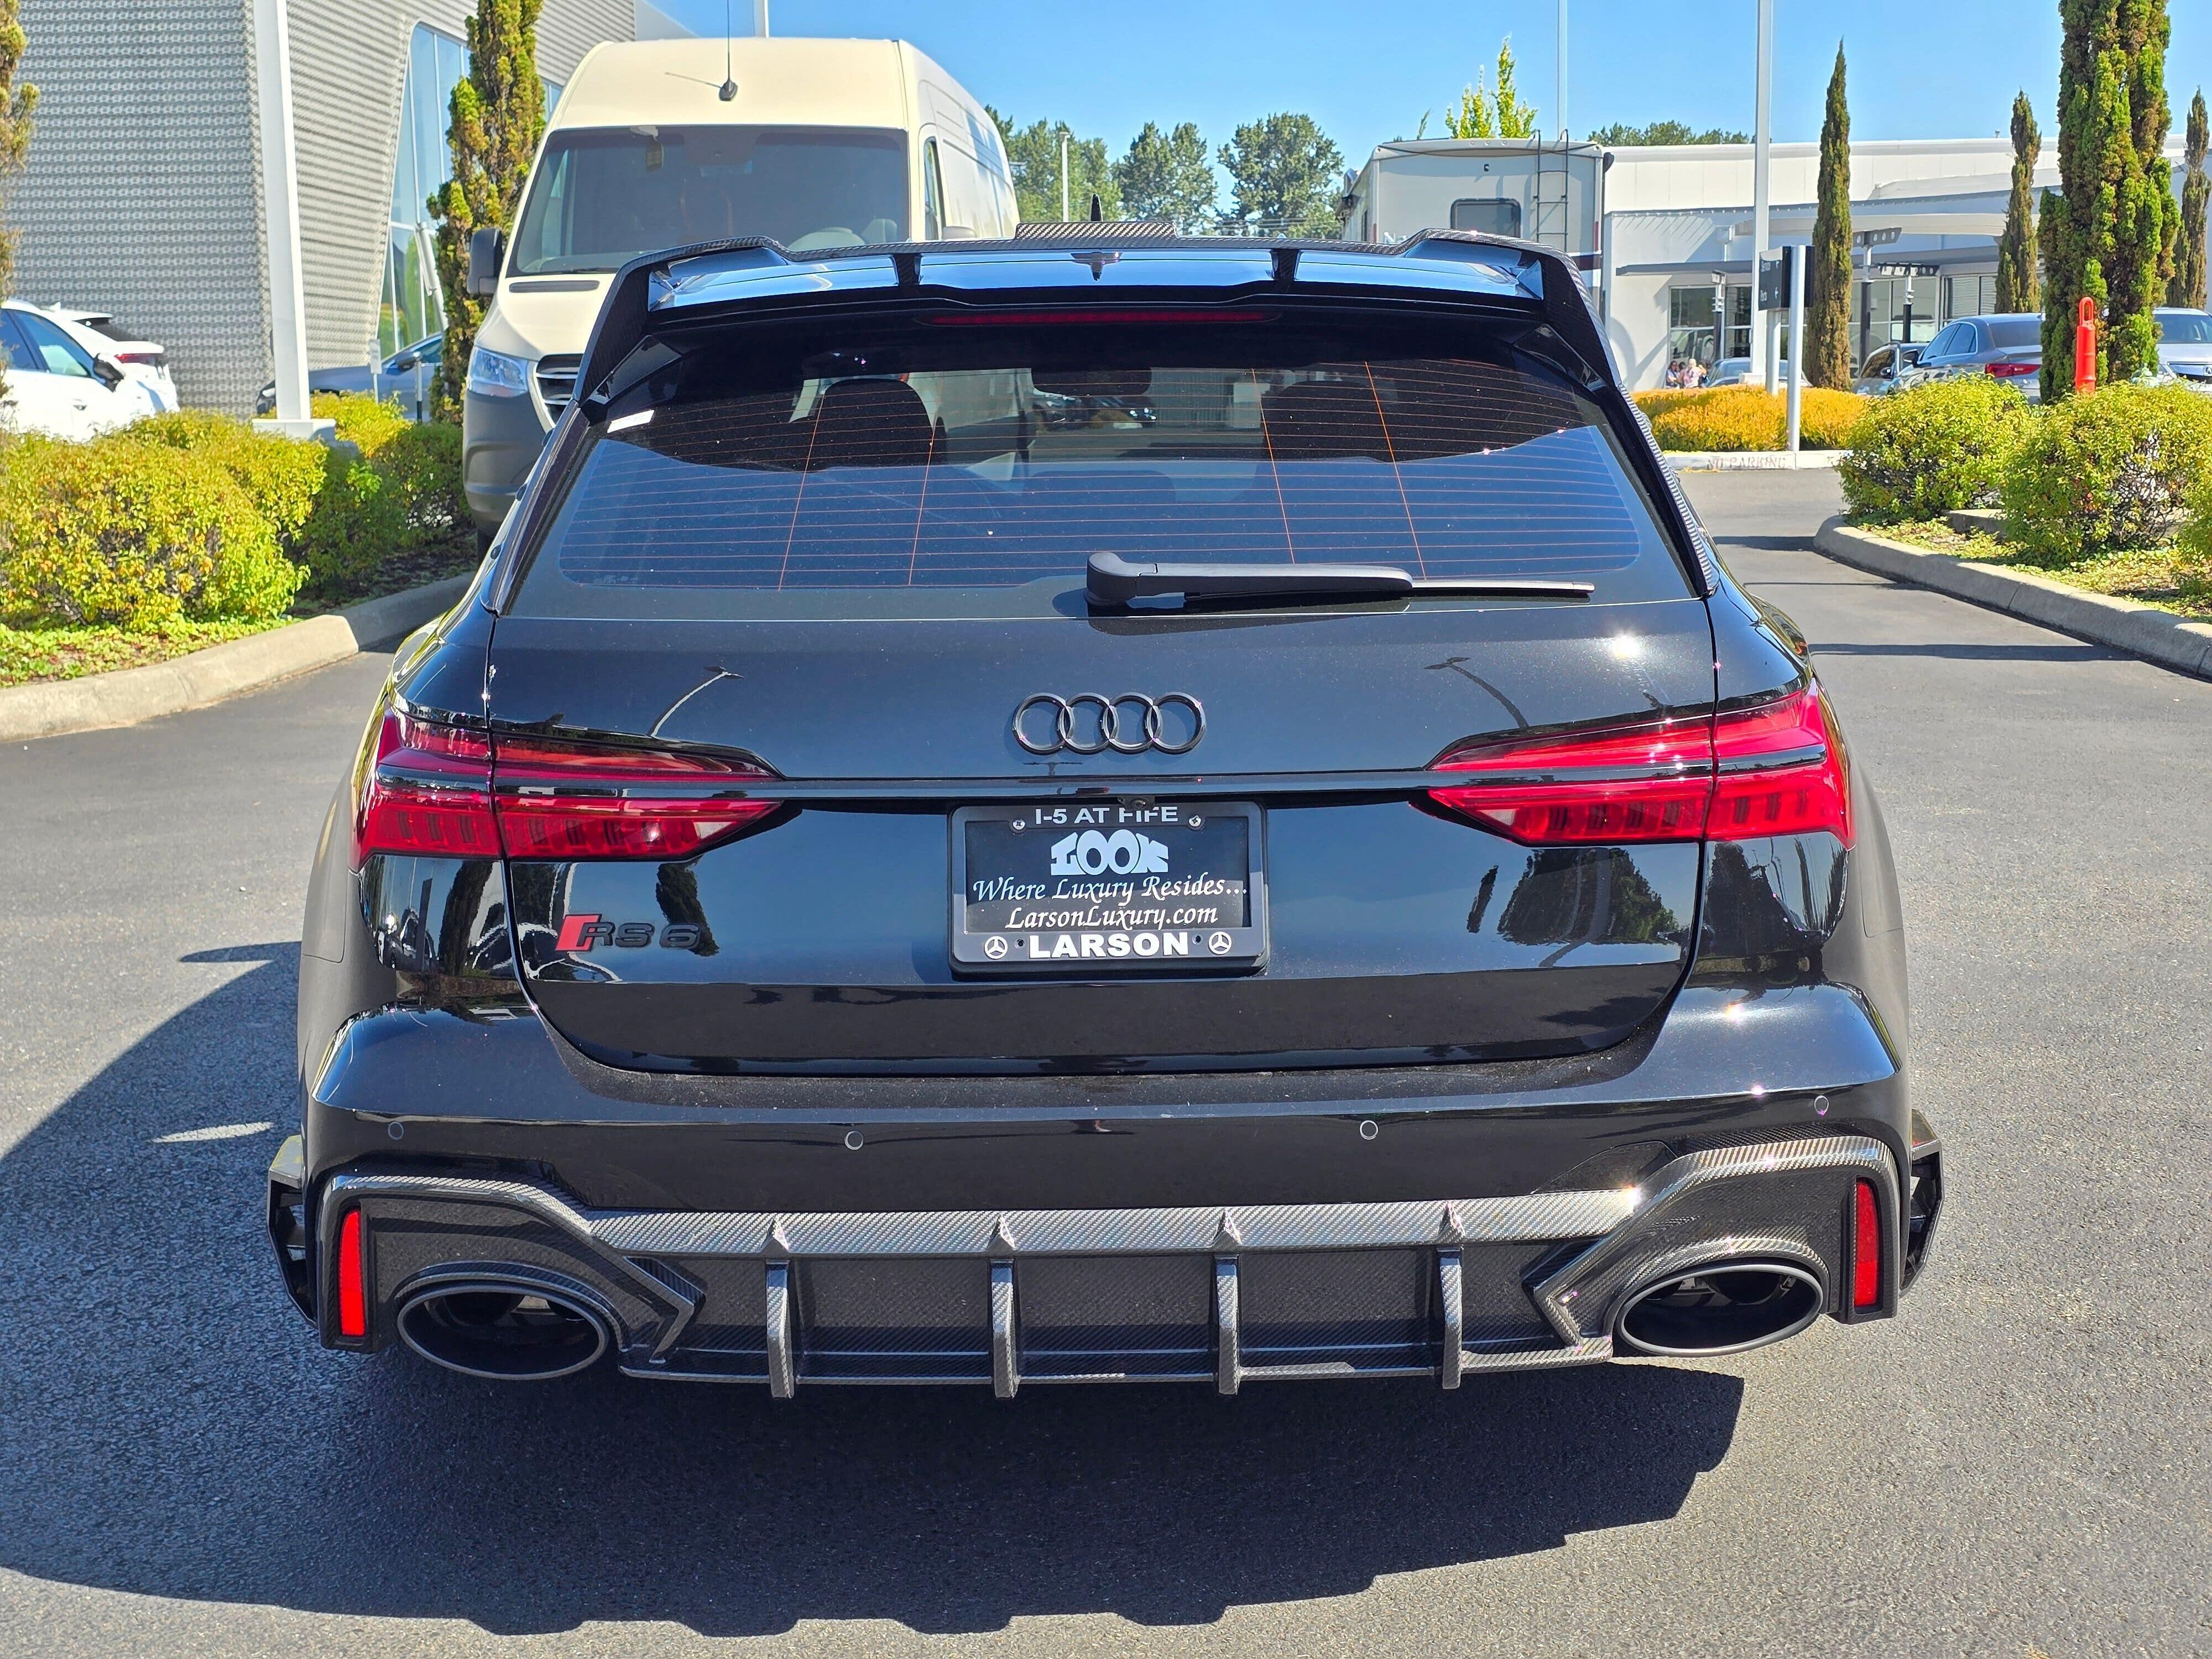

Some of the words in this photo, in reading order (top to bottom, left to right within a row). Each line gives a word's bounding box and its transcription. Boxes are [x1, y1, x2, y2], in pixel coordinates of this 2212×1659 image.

[1728, 456, 1785, 468] PARKING
[1036, 808, 1067, 825] I-5
[1074, 807, 1110, 823] AT
[1119, 806, 1178, 823] FIFE
[1051, 829, 1168, 875] LOOK
[973, 877, 1046, 901] Where
[1052, 879, 1134, 906] Luxury
[1141, 872, 1247, 900] Resides...
[1005, 905, 1218, 930] LarsonLuxury.com
[1029, 932, 1189, 958] LARSON
